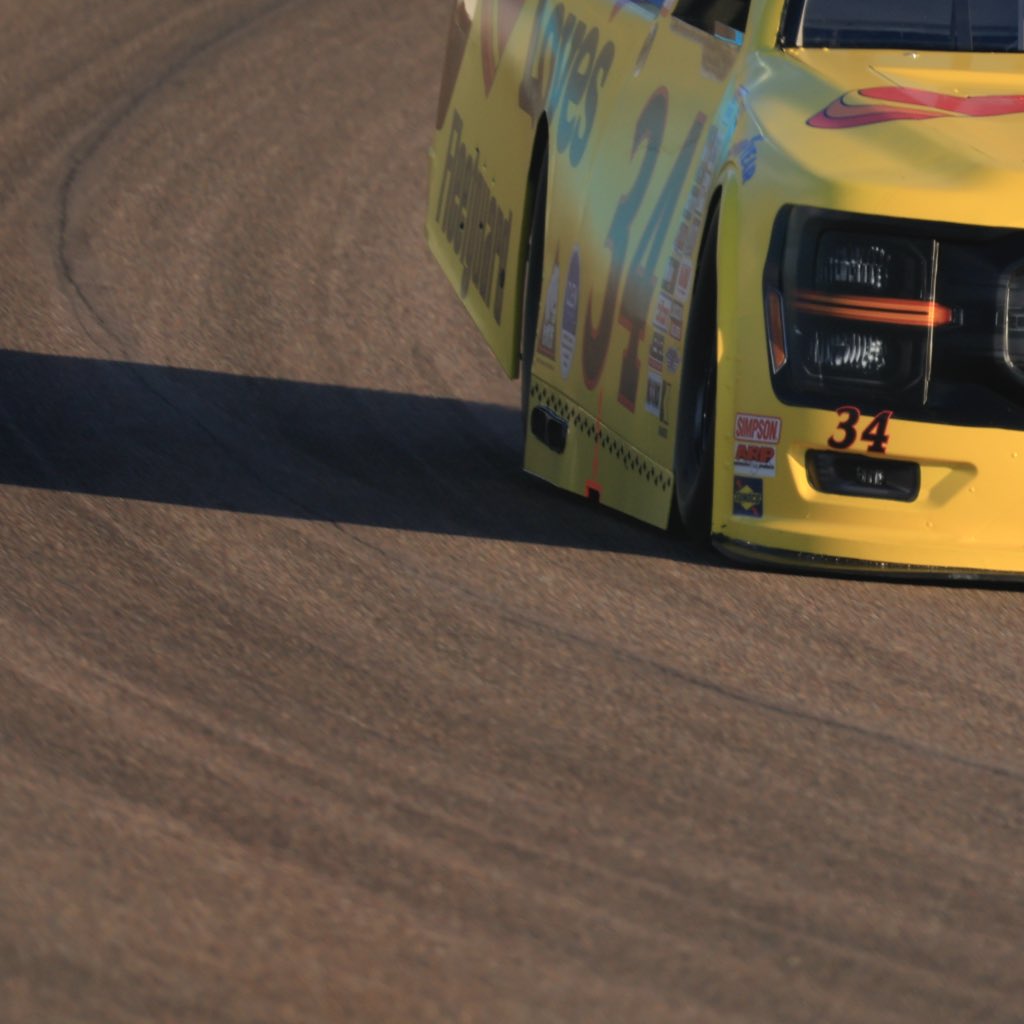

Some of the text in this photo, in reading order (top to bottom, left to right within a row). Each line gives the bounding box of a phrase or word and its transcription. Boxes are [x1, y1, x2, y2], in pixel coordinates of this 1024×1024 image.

[736, 416, 778, 441] SIMPSON
[827, 405, 895, 454] 34
[736, 444, 775, 464] ARP
